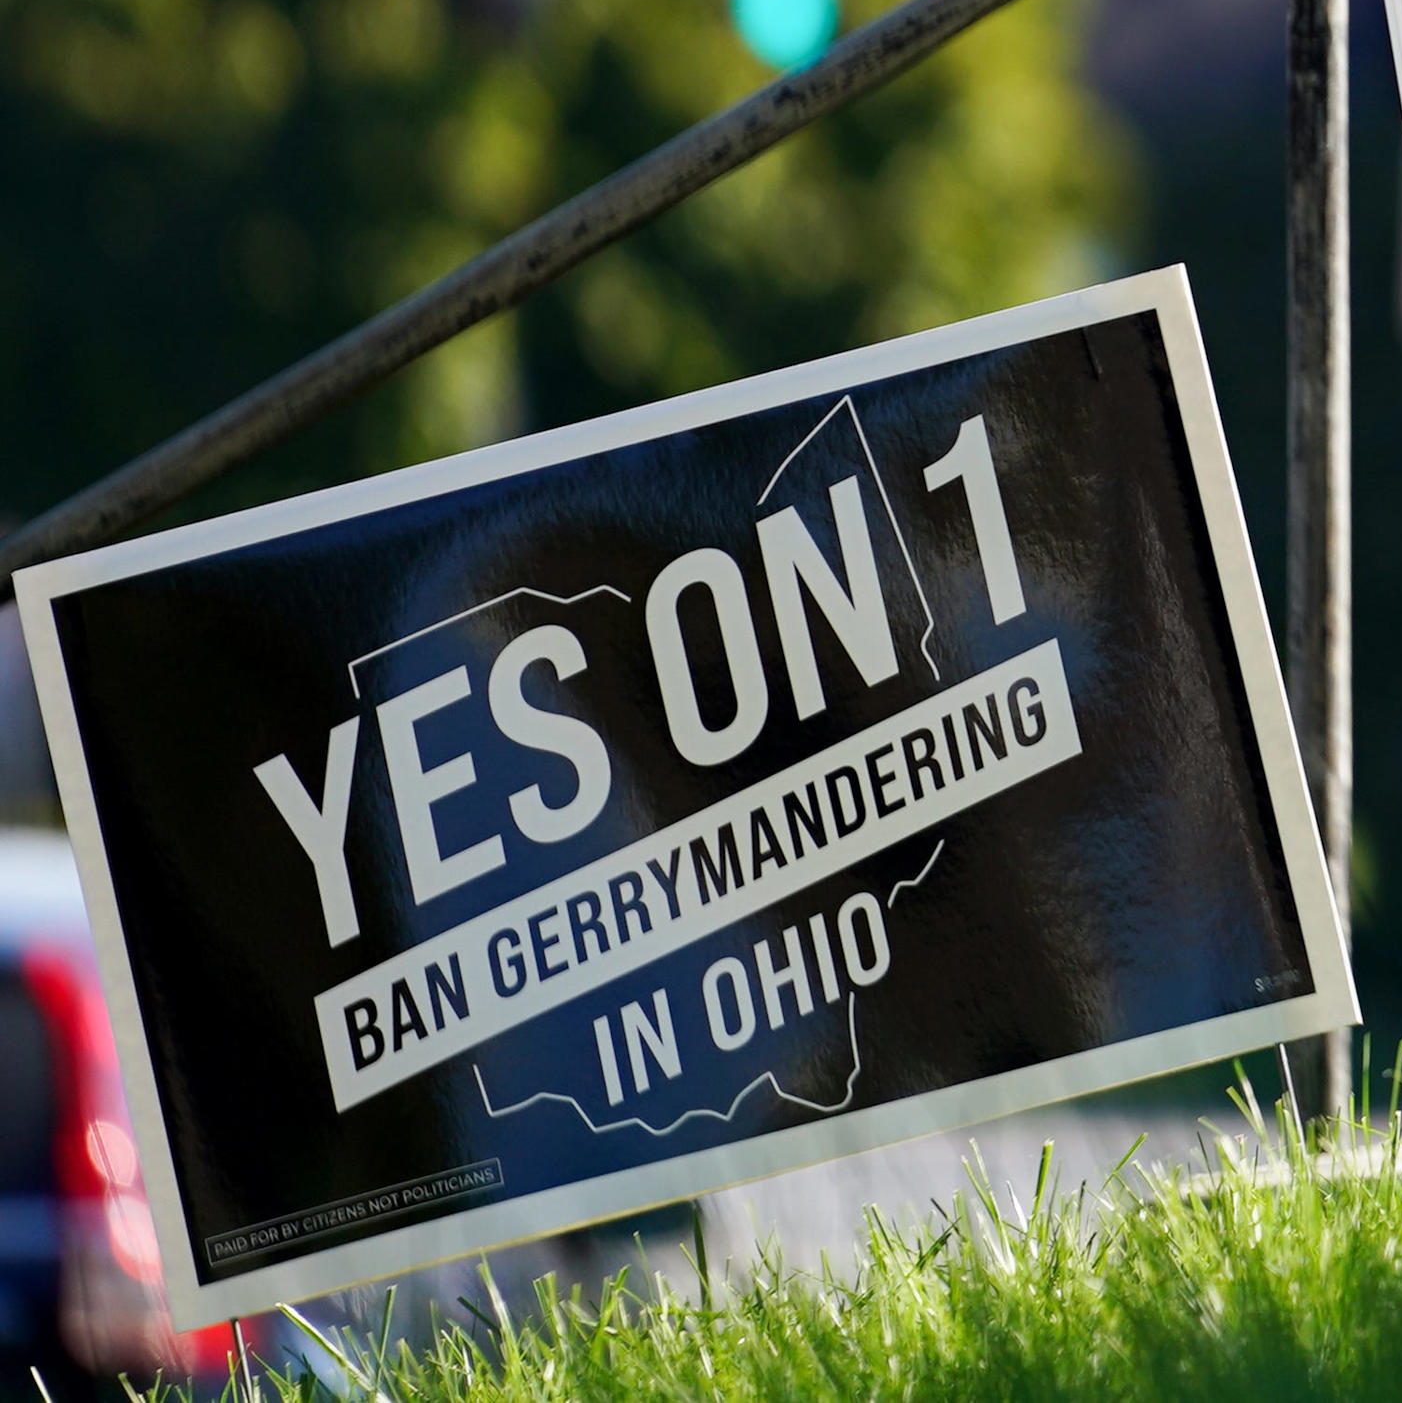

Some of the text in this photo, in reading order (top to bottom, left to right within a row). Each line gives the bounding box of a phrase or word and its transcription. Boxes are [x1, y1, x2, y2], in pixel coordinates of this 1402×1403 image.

[254, 415, 1028, 948] YES ON 1
[343, 676, 1048, 1070] BAN GERRYMANDERING
[594, 891, 893, 1106] IN OHIO
[214, 1167, 494, 1258] PAID FOR BY CITIZENS NOT POLITICIANS
